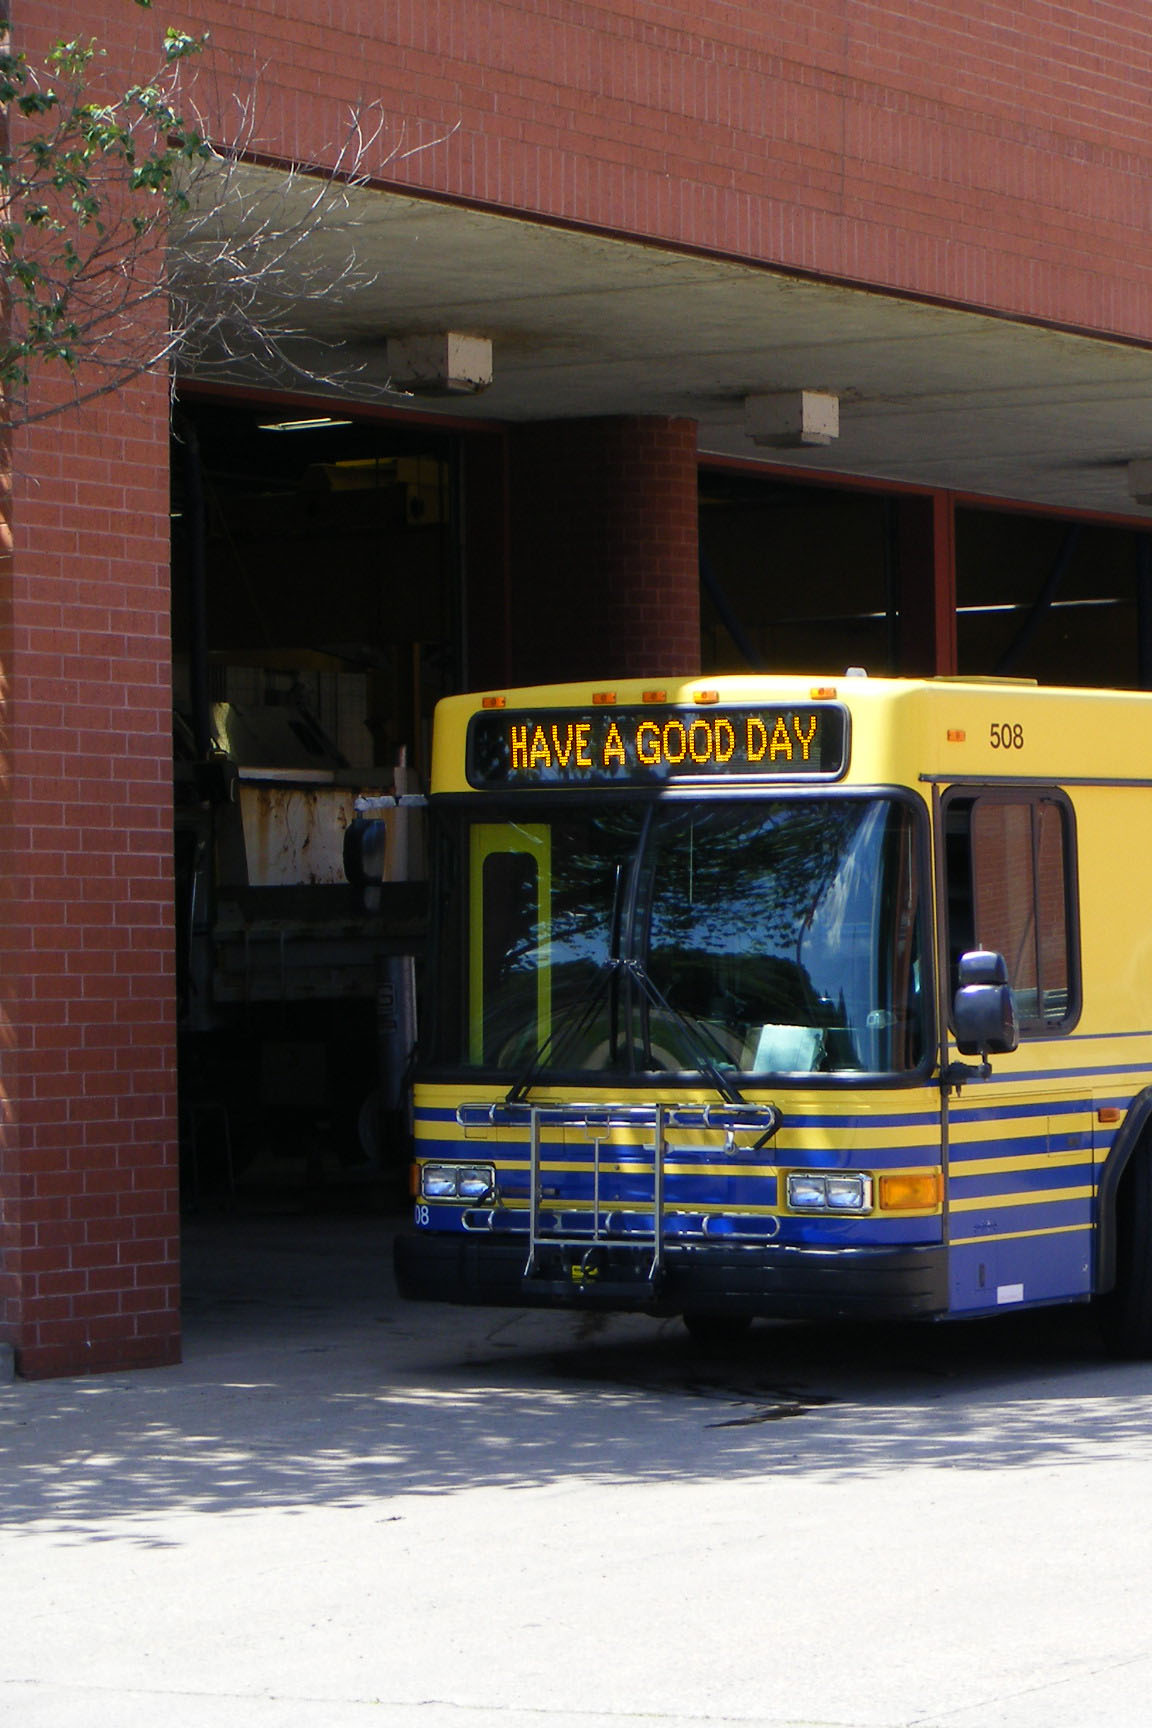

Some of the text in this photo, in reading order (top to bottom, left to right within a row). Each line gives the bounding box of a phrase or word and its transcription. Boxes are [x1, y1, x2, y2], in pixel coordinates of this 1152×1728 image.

[510, 715, 818, 768] HAVE A GOOD DAY
[990, 723, 1024, 749] 508
